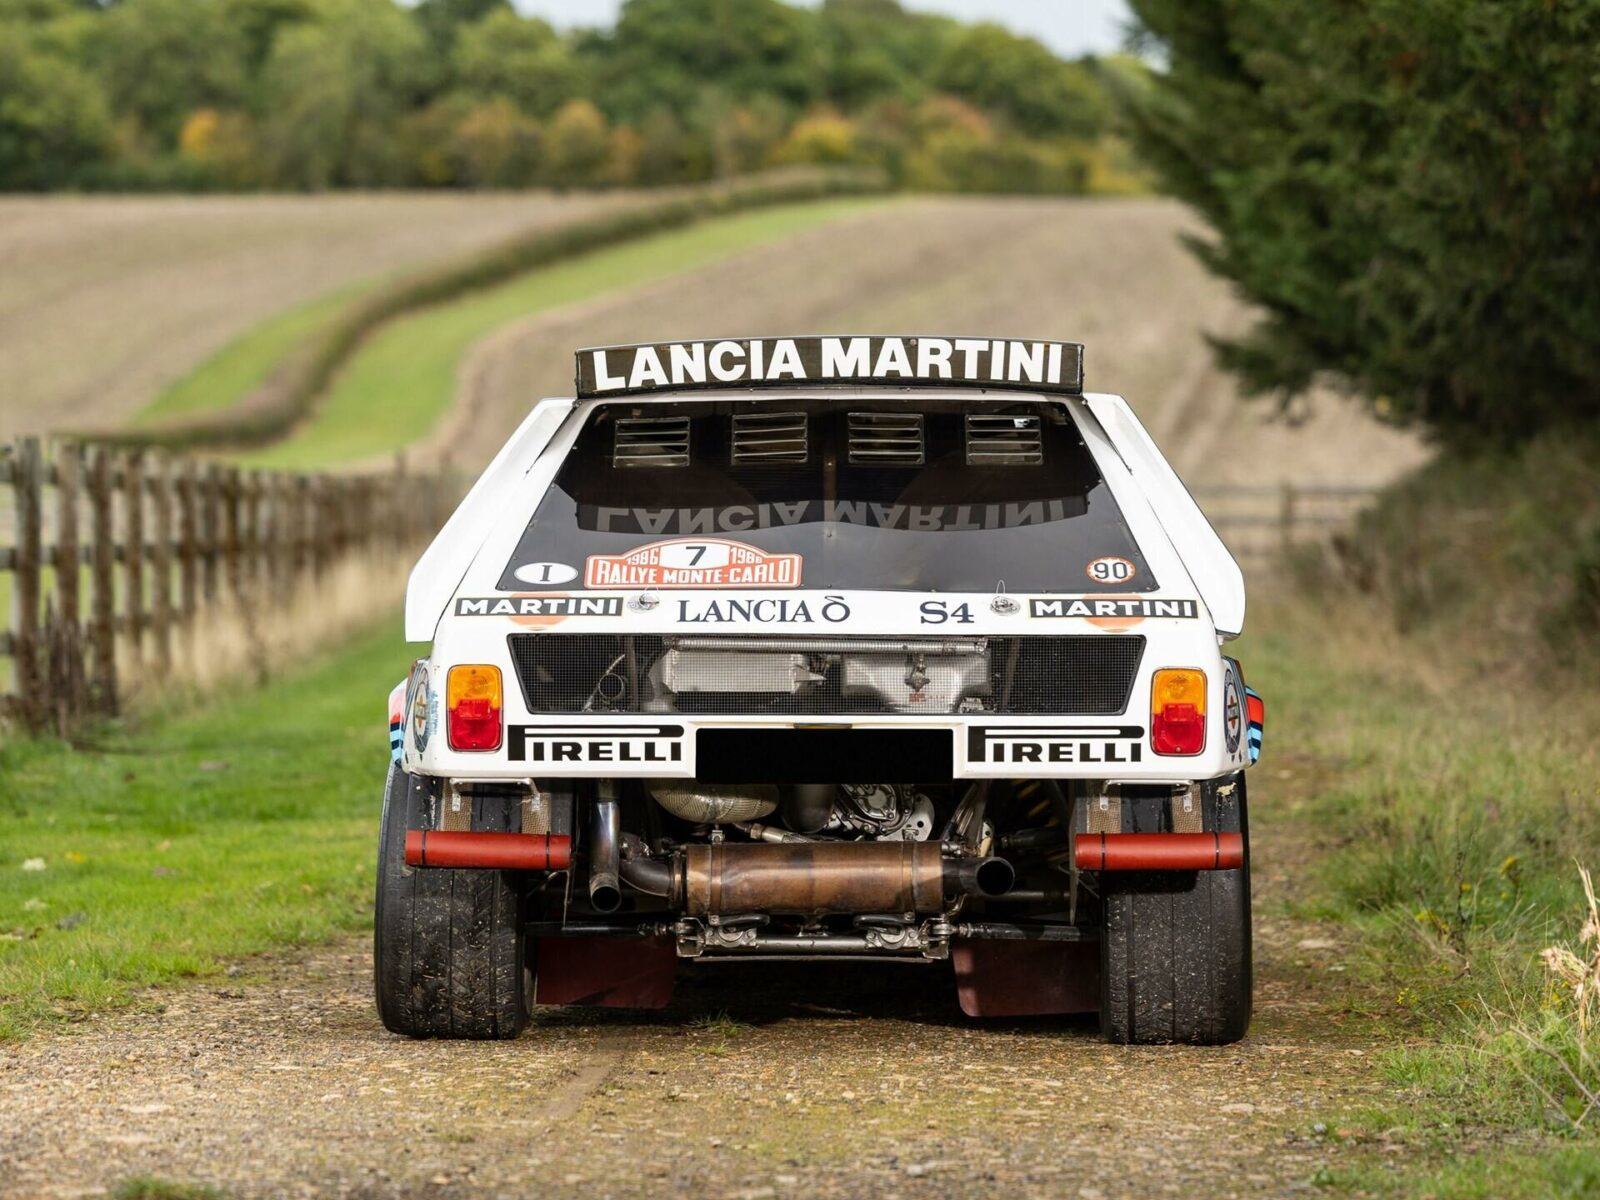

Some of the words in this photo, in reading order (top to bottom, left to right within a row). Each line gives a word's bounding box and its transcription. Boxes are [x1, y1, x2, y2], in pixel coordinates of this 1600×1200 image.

[593, 339, 807, 391] LANCIA
[821, 337, 1063, 384] MARTINI
[626, 547, 660, 566] 1986
[685, 546, 707, 567] 7
[539, 565, 553, 582] I
[596, 559, 657, 584] RALLYE
[662, 561, 793, 584] MONTE-CARLO
[1094, 562, 1128, 580] 90
[460, 599, 618, 615] MARTINI
[677, 600, 815, 623] LANCIA
[919, 601, 975, 624] S4
[1035, 601, 1192, 617] MARTINI
[508, 725, 685, 761] PIRELLI
[968, 726, 1145, 762] PIRELLI
